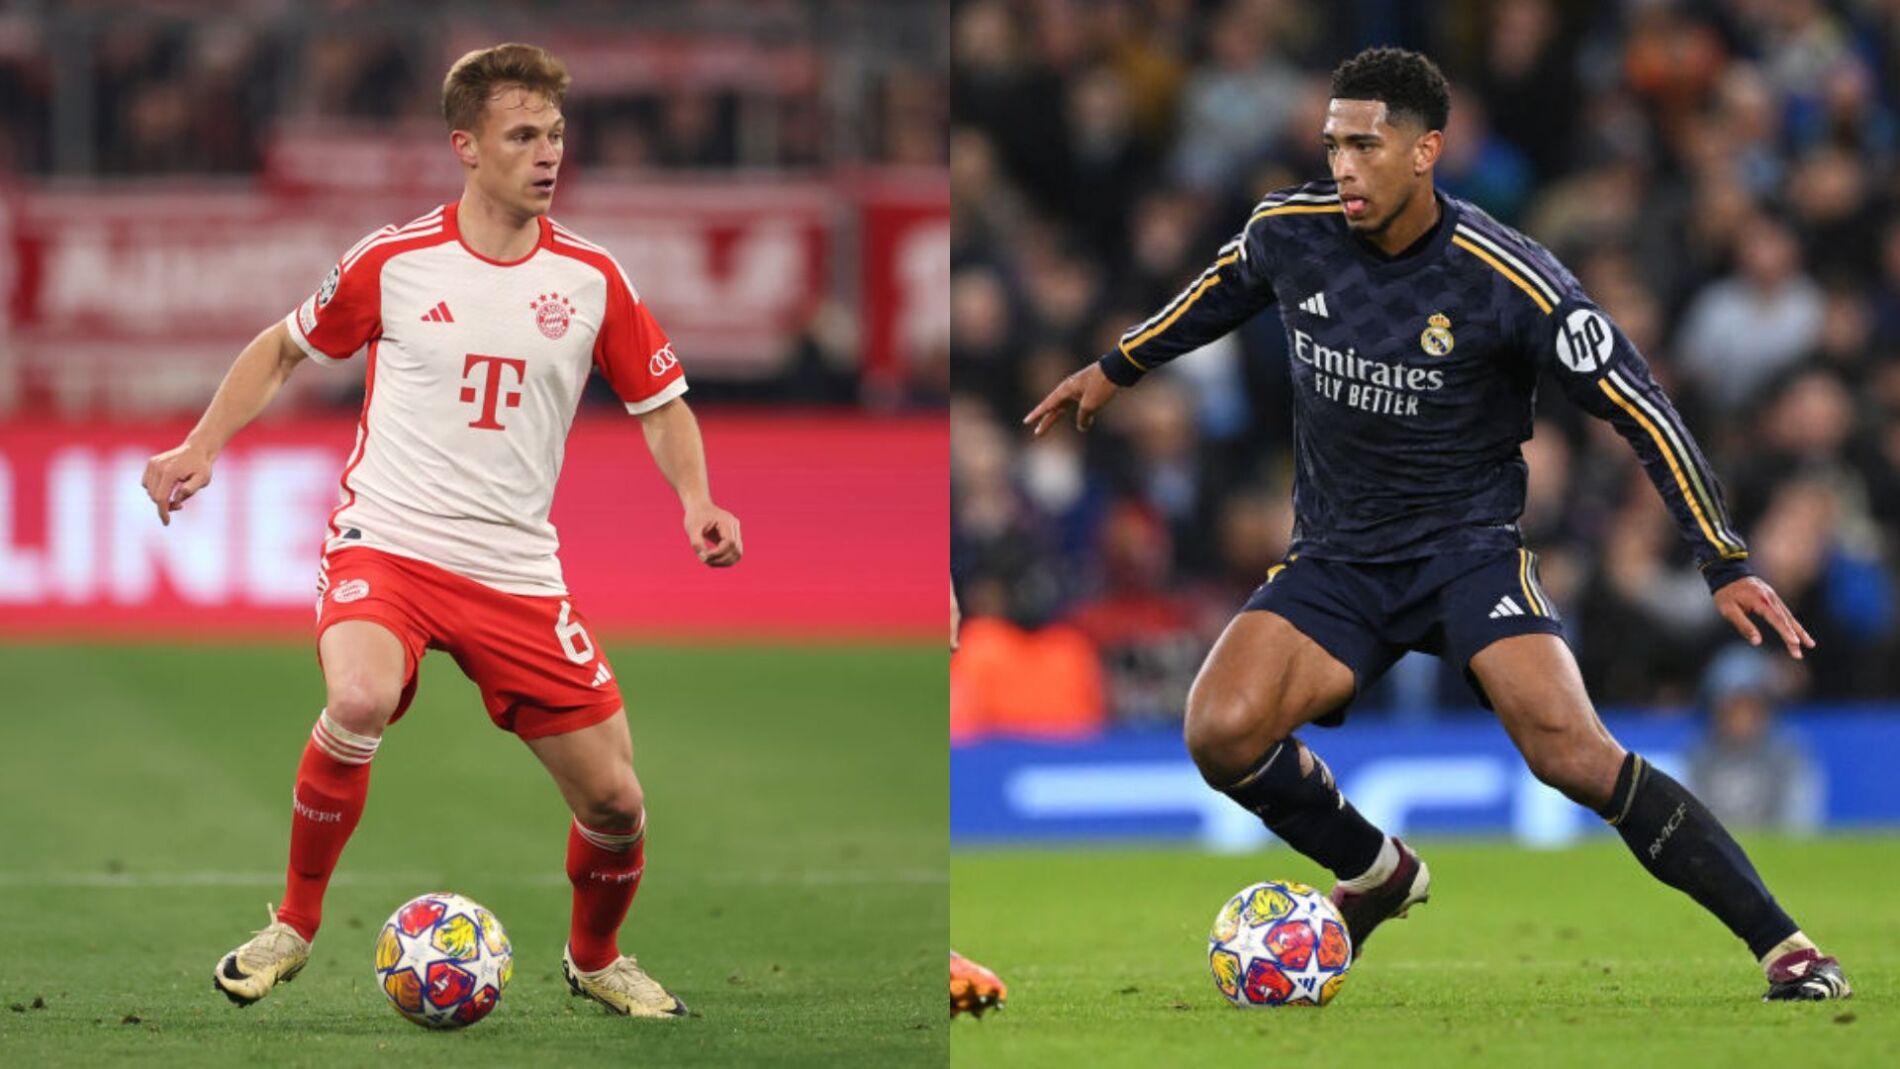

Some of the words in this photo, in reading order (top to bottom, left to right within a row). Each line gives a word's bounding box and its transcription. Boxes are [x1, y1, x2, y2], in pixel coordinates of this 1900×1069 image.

[1294, 329, 1444, 391] Emirates
[1558, 310, 1608, 371] hp
[459, 353, 526, 431] T
[1315, 372, 1342, 402] FLY
[1348, 384, 1419, 416] BETTER
[555, 600, 595, 665] 6
